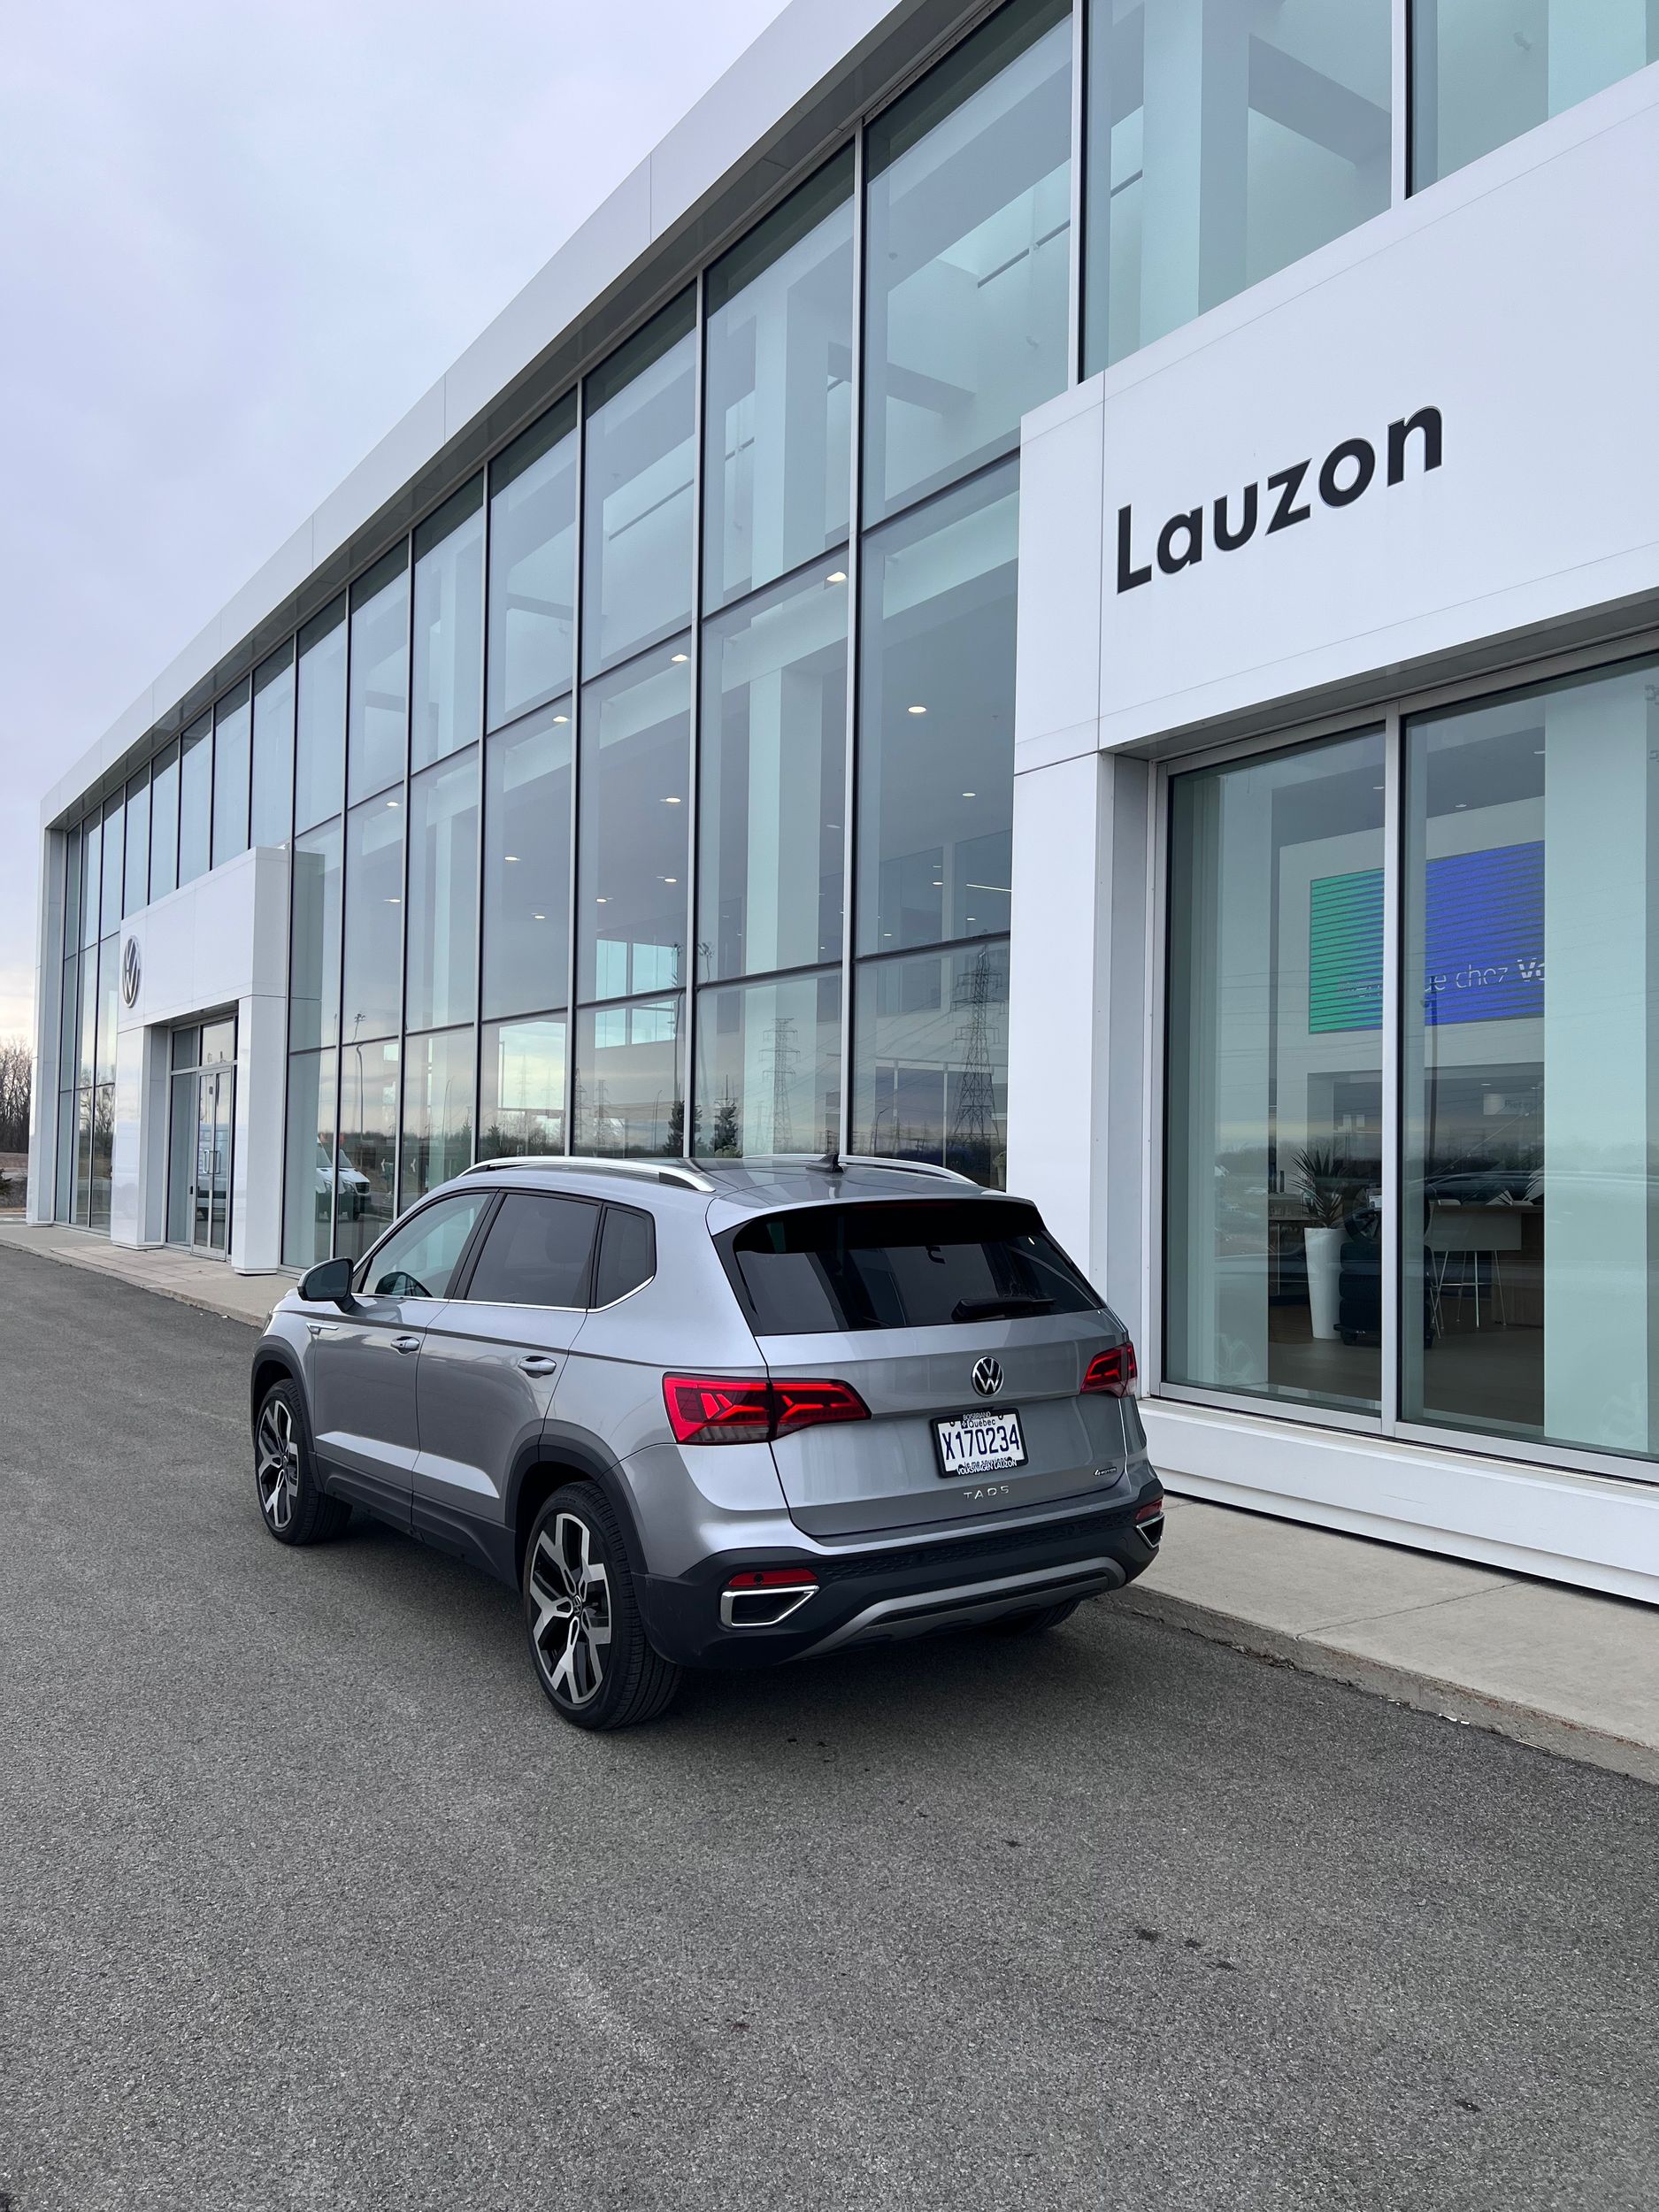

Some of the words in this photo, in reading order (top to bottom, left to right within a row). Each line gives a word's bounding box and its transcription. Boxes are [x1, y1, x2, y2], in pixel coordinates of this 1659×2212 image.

[1118, 405, 1443, 595] Lauzon
[1455, 964, 1509, 989] chez
[941, 1424, 1020, 1461] X170234
[956, 1461, 994, 1476] VOLKSWAGEN
[994, 1459, 1018, 1471] LAUZON
[964, 1486, 1010, 1500] TAOS
